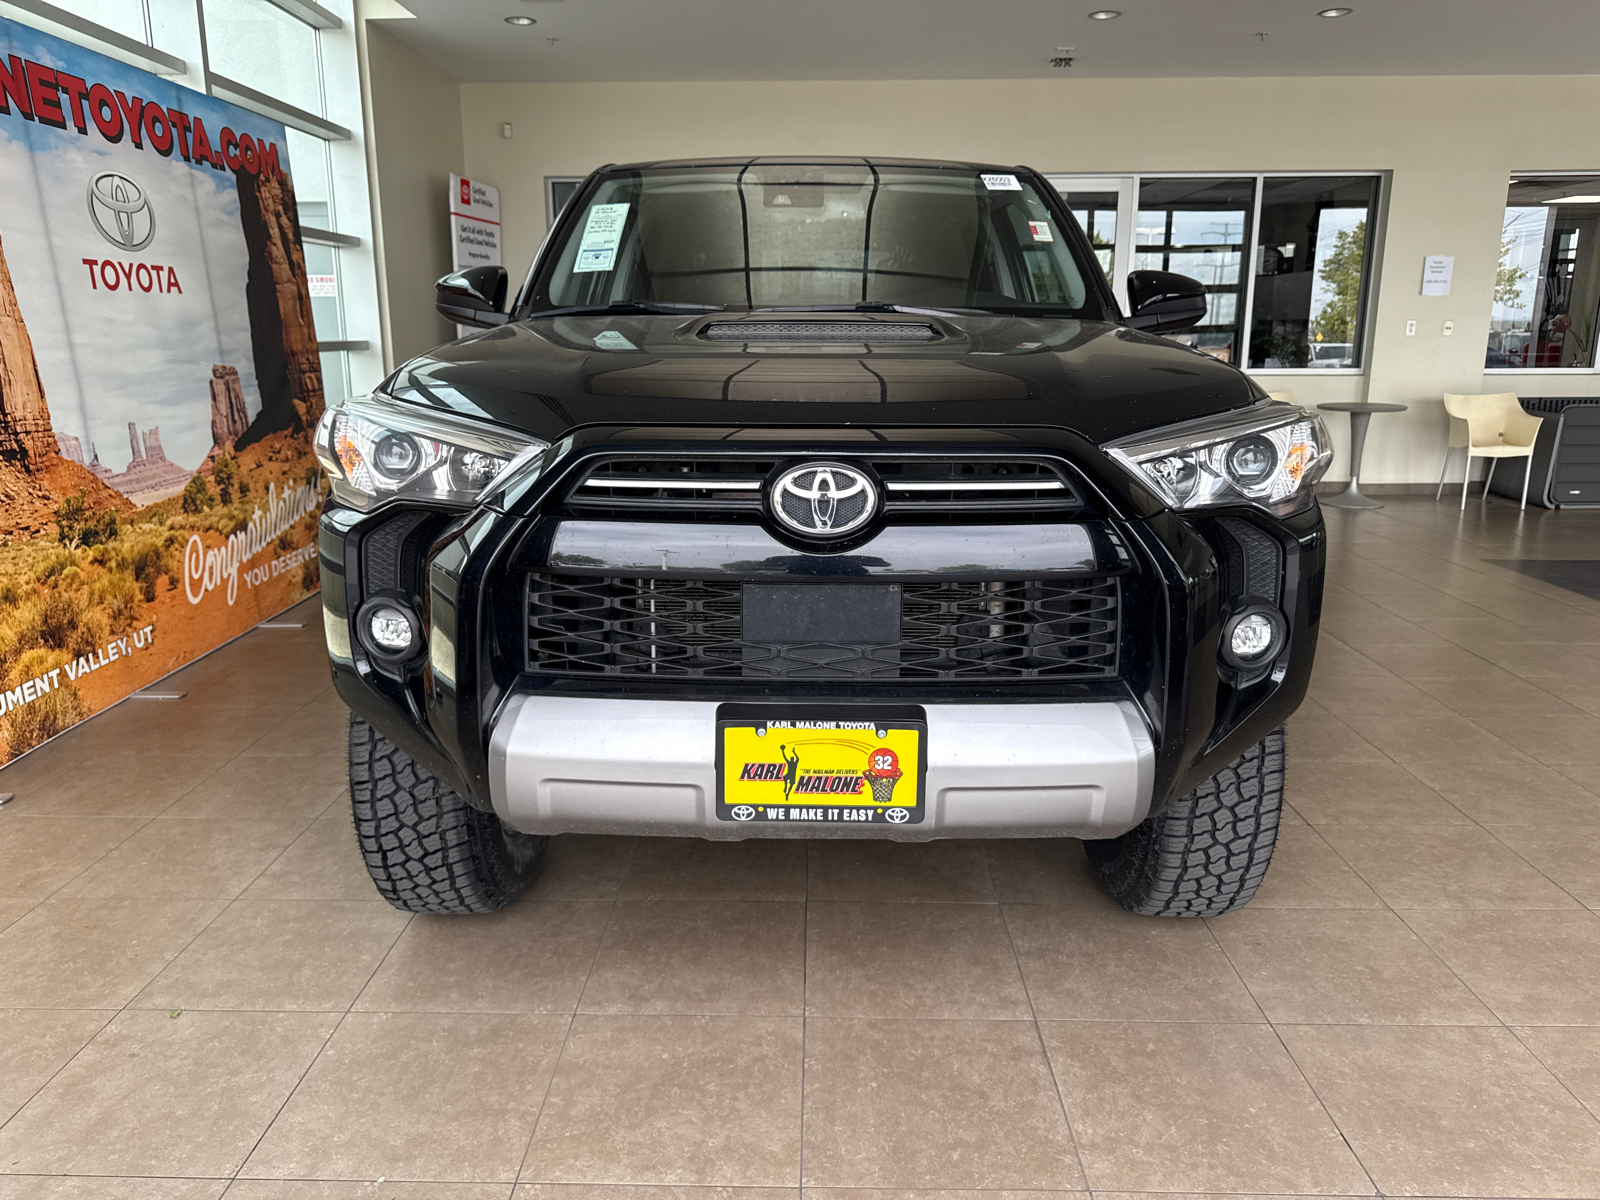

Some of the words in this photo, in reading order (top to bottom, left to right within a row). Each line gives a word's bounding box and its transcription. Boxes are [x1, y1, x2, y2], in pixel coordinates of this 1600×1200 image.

[82, 258, 183, 295] TOYOTA
[244, 564, 270, 589] YOU
[271, 542, 318, 577] DESERVE
[64, 636, 132, 682] VALLEY,
[133, 625, 153, 649] UT
[766, 720, 794, 730] KARL
[796, 721, 836, 730] MALONE
[839, 721, 876, 731] TOYOTA
[874, 755, 893, 770] 32
[739, 763, 786, 781] KARL
[794, 775, 865, 794] MALONE
[767, 807, 785, 820] WE
[790, 808, 823, 820] MAKE
[828, 808, 839, 821] IT
[843, 808, 874, 821] EASY
